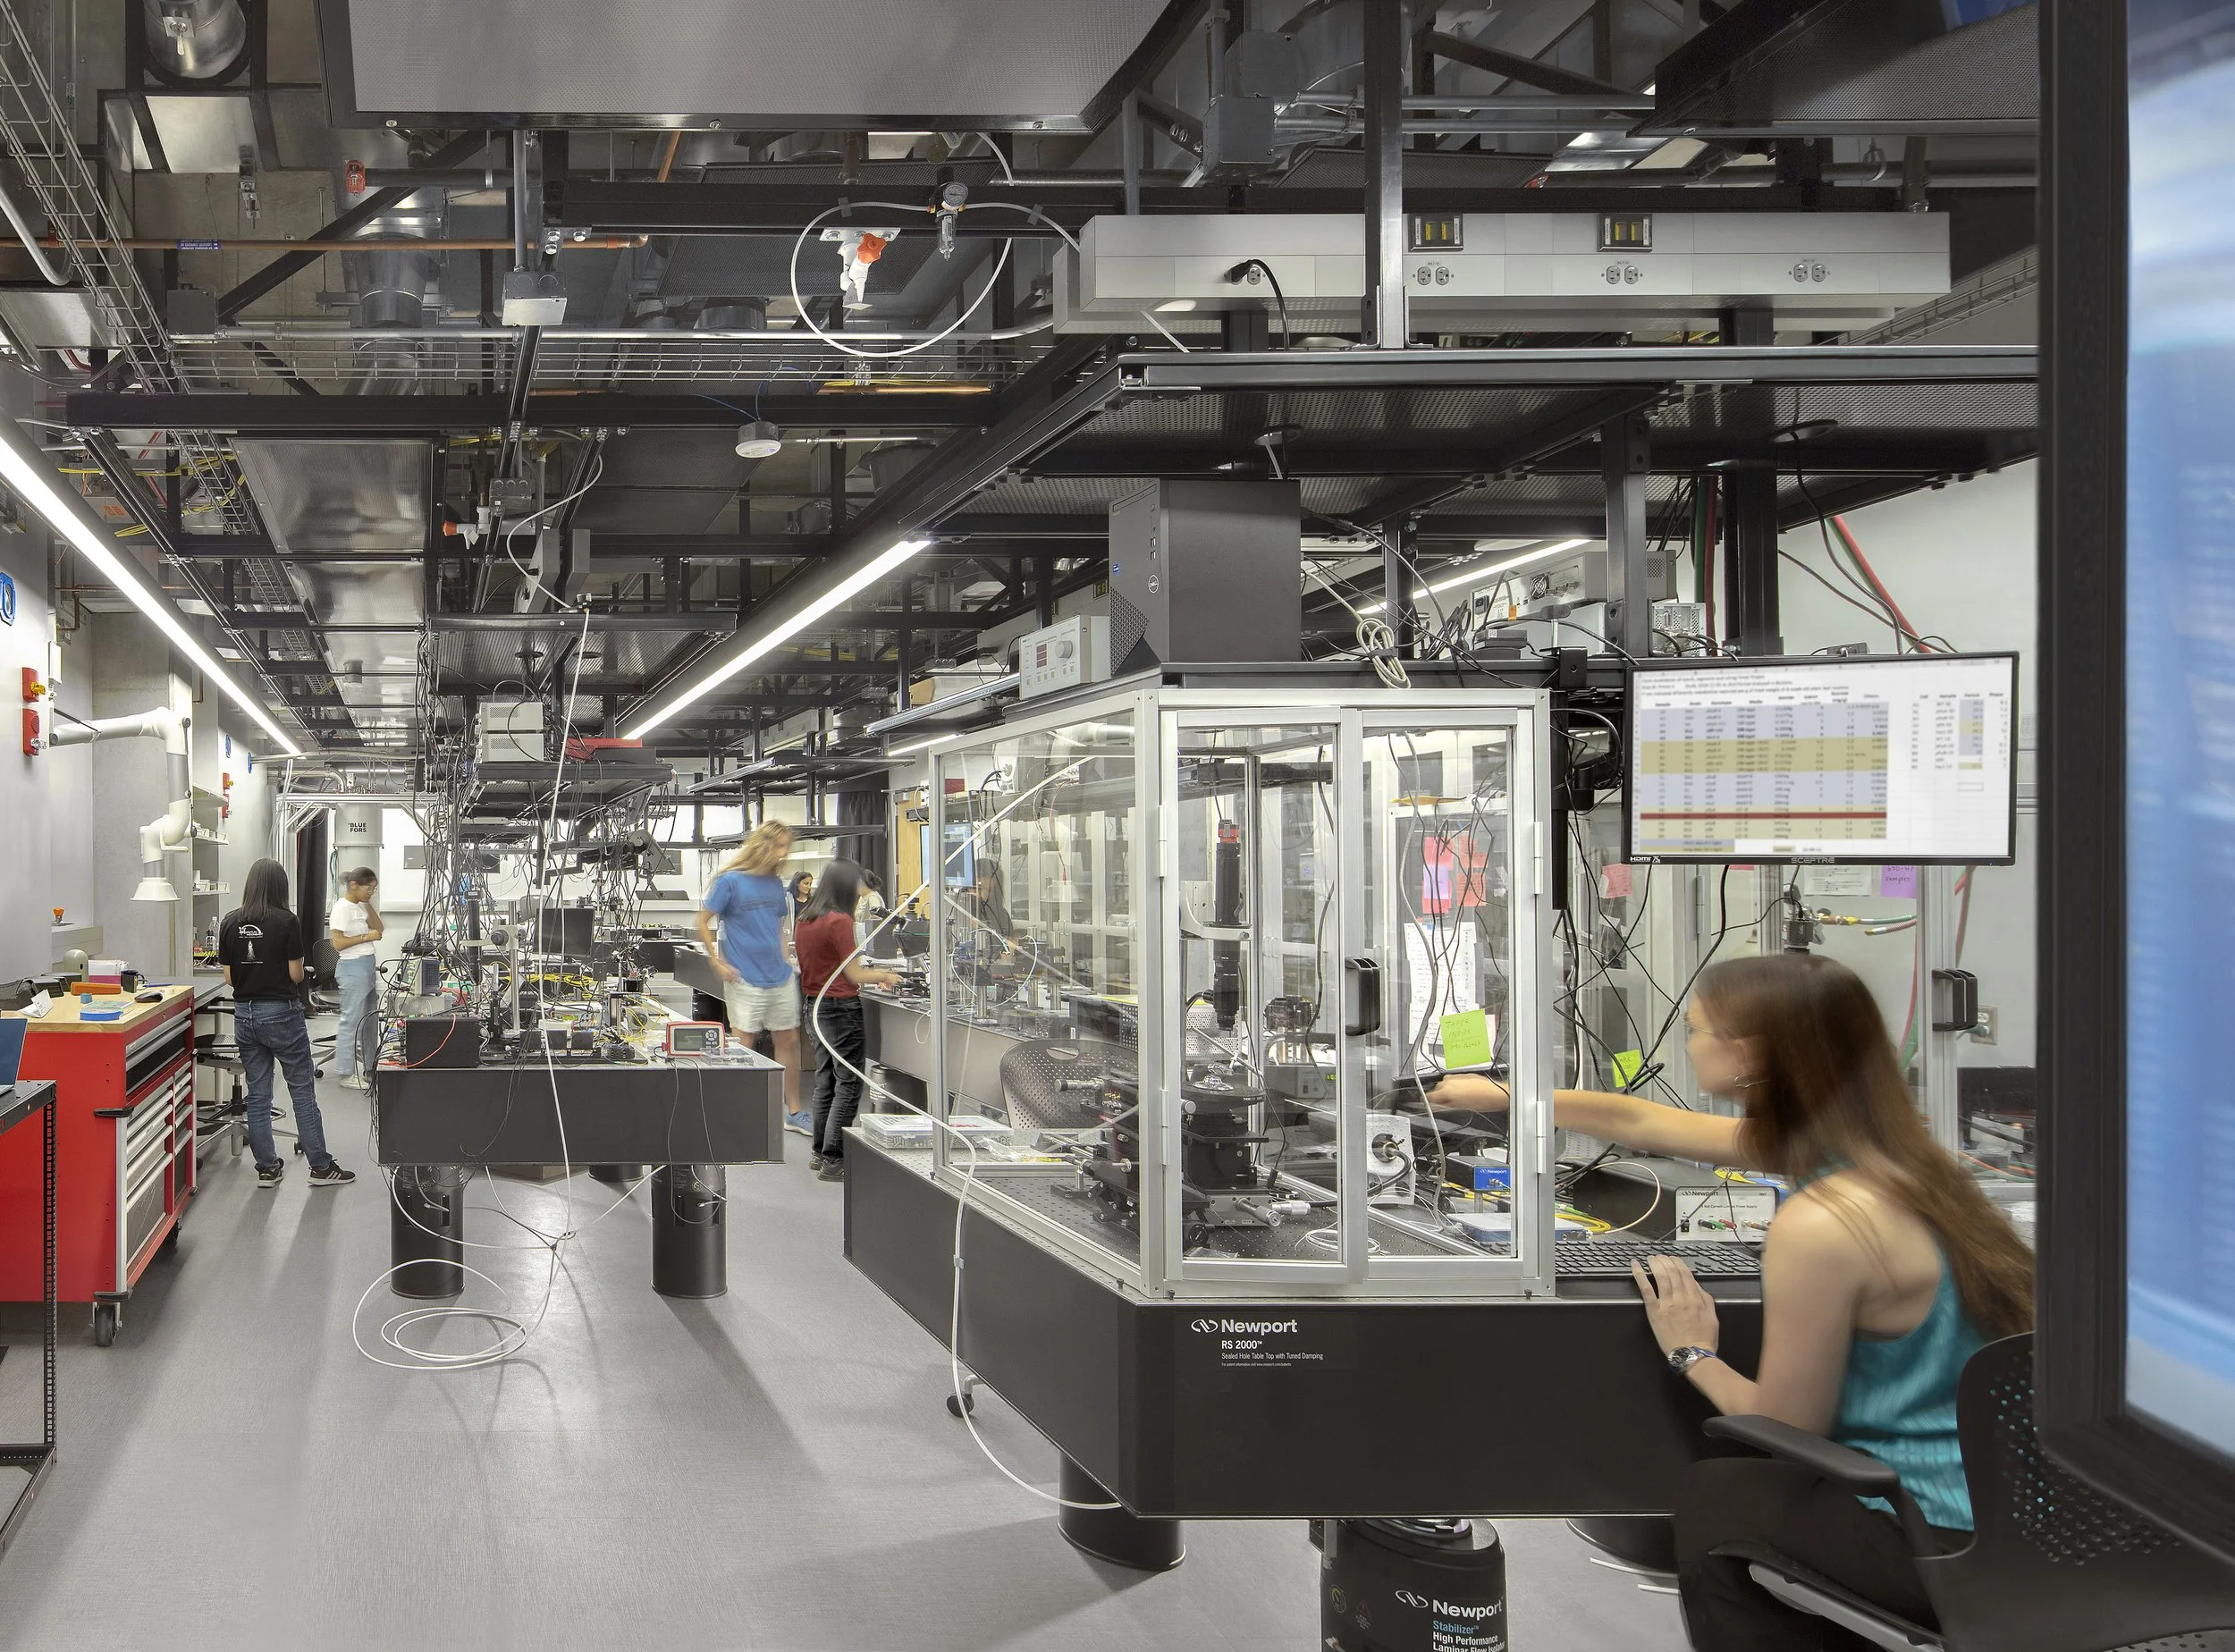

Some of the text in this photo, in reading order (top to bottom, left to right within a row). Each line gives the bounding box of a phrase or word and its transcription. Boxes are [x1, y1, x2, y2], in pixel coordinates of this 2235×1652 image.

[1221, 1319, 1298, 1336] Newport
[1221, 1340, 1233, 1350] RS
[1265, 1353, 1274, 1361] Top
[1302, 1353, 1324, 1361] Damping
[1432, 1598, 1502, 1621] Newport
[1432, 1631, 1497, 1646] High Performance
[1432, 1641, 1468, 1652] Laminar
